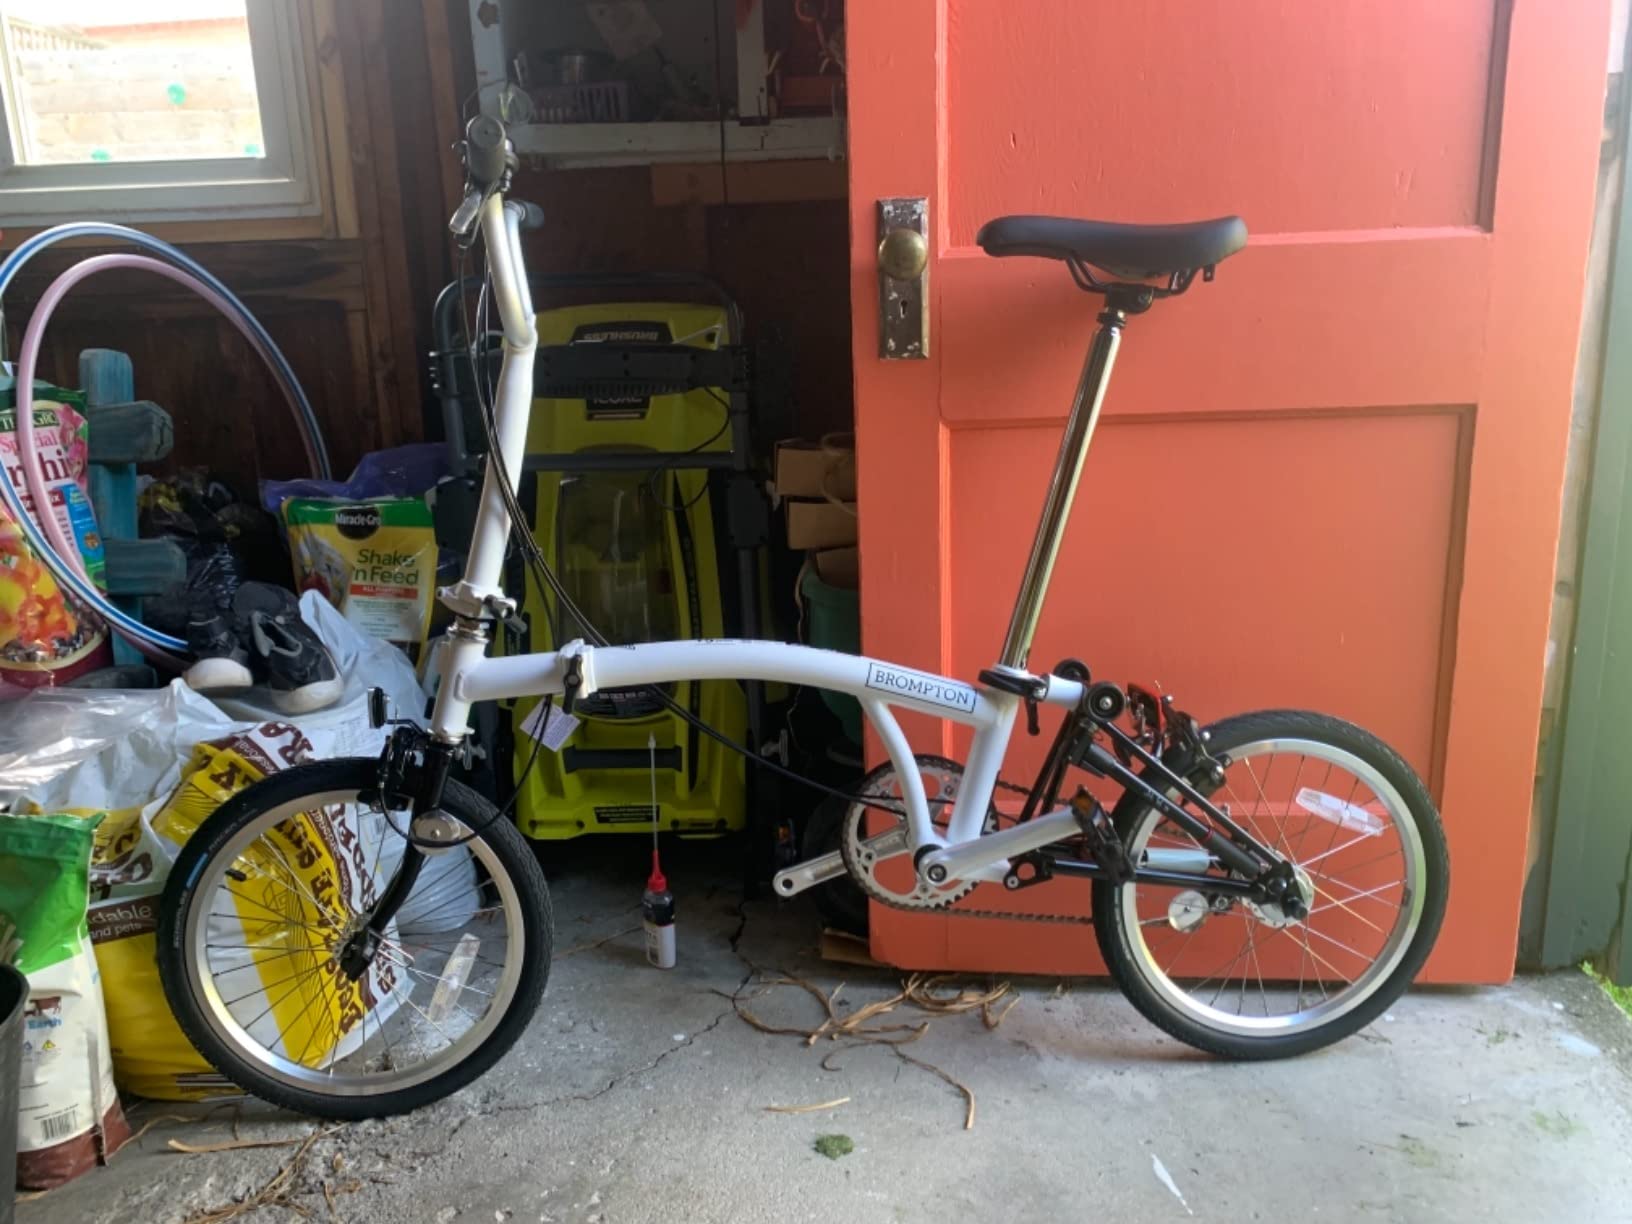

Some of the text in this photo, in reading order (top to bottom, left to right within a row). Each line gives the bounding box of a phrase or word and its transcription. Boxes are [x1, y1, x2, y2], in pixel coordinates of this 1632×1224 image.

[335, 513, 382, 527] Miracle-Gro
[356, 550, 416, 568] Shake
[370, 566, 419, 585] Feed
[875, 670, 970, 705] BROMPTON
